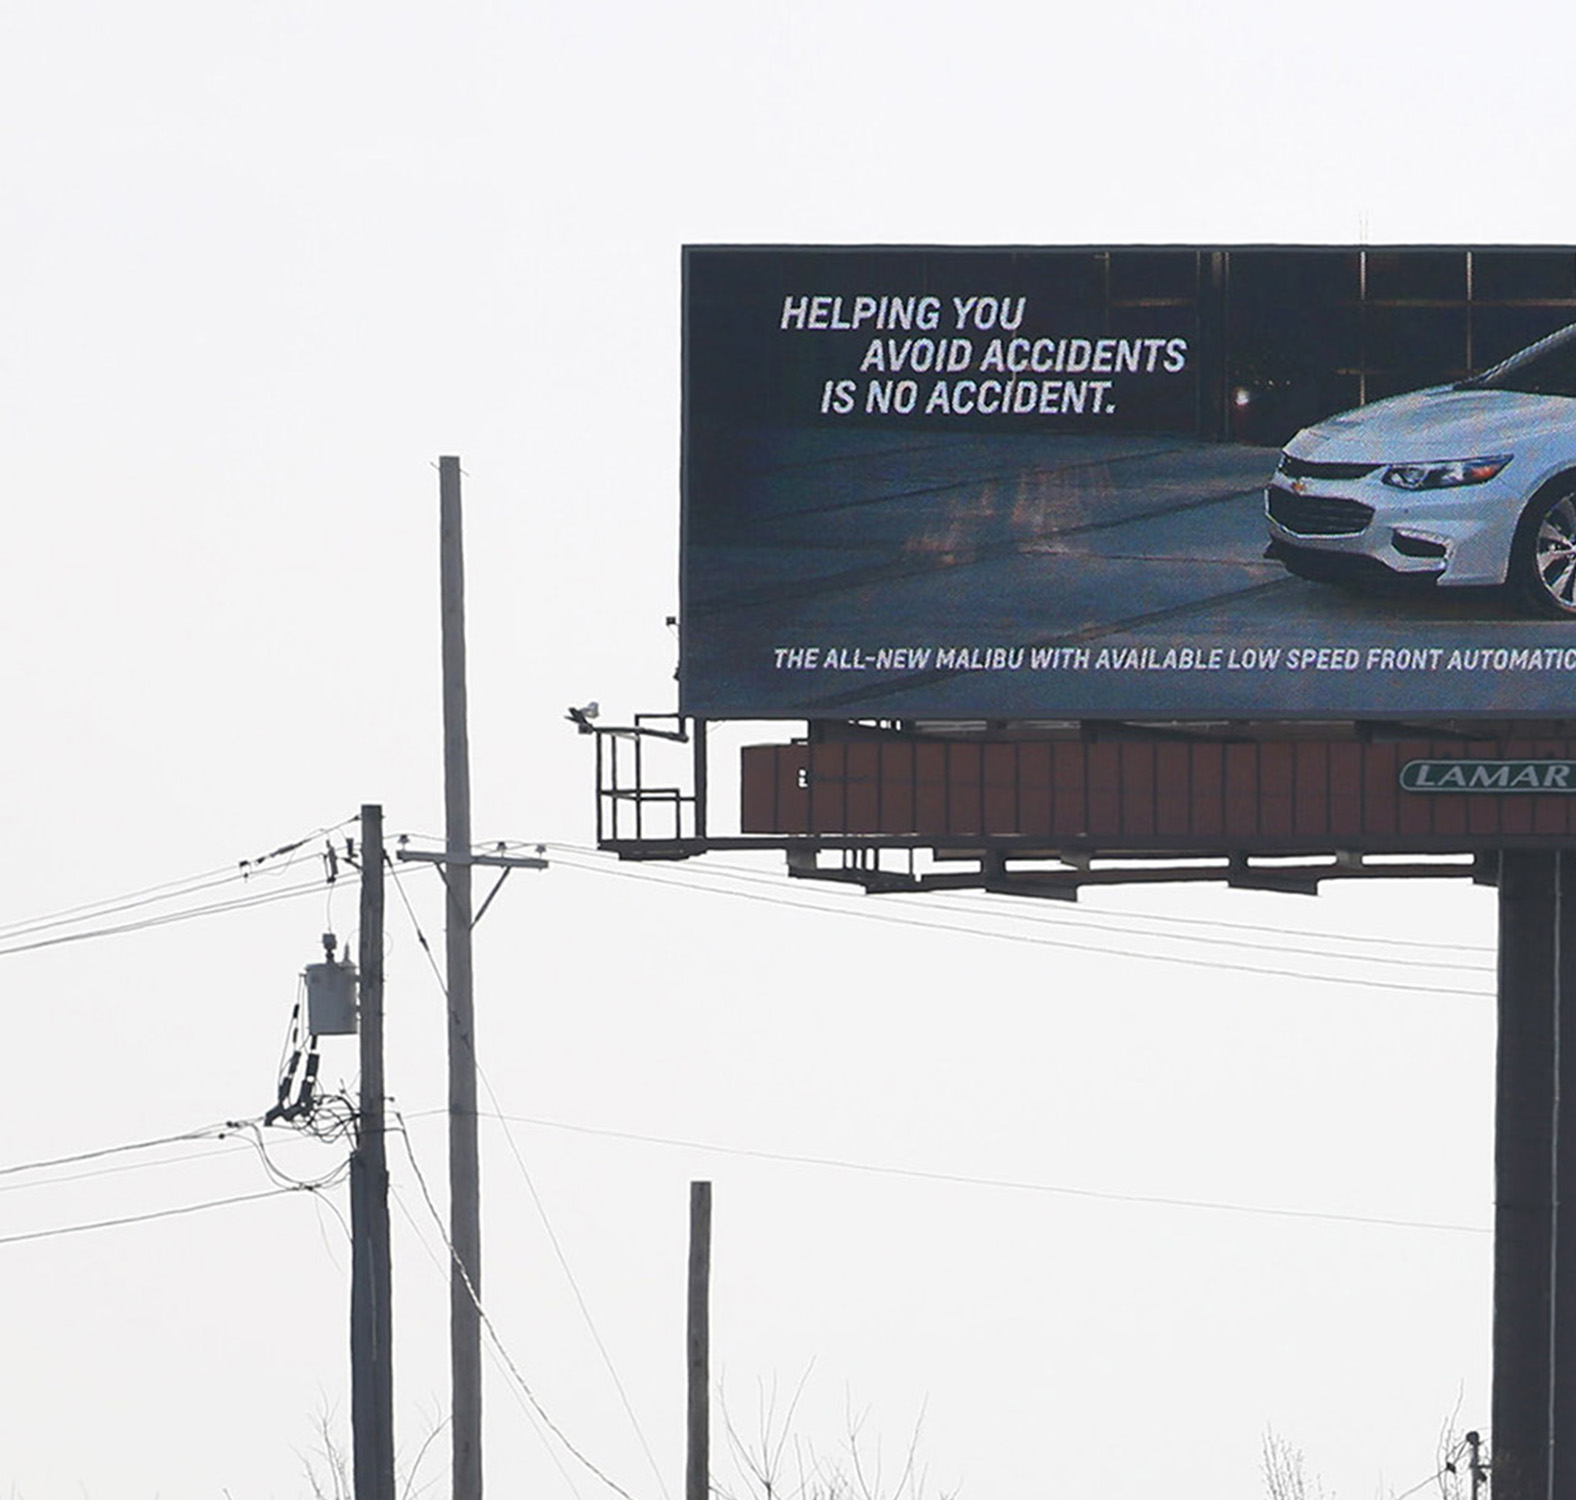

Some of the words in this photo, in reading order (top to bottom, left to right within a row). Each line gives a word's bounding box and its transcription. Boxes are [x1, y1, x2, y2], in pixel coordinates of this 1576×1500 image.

[781, 296, 941, 330] HELPING
[952, 297, 1026, 330] YOU
[860, 338, 972, 372] AVOID
[979, 338, 1187, 373] ACCIDENTS
[821, 380, 857, 414] IS
[865, 380, 918, 414] NO
[925, 380, 1116, 414] ACCIDENT.
[774, 647, 820, 669] THE
[823, 647, 931, 669] ALL-NEW
[936, 647, 1024, 669] MALIBU
[1031, 648, 1090, 669] WITH
[1095, 648, 1223, 669] AVAILABLE
[1227, 648, 1281, 669] LOW
[1286, 648, 1360, 670] SPEED
[1366, 648, 1443, 670] FRONT
[1415, 764, 1571, 787] LAMAR
